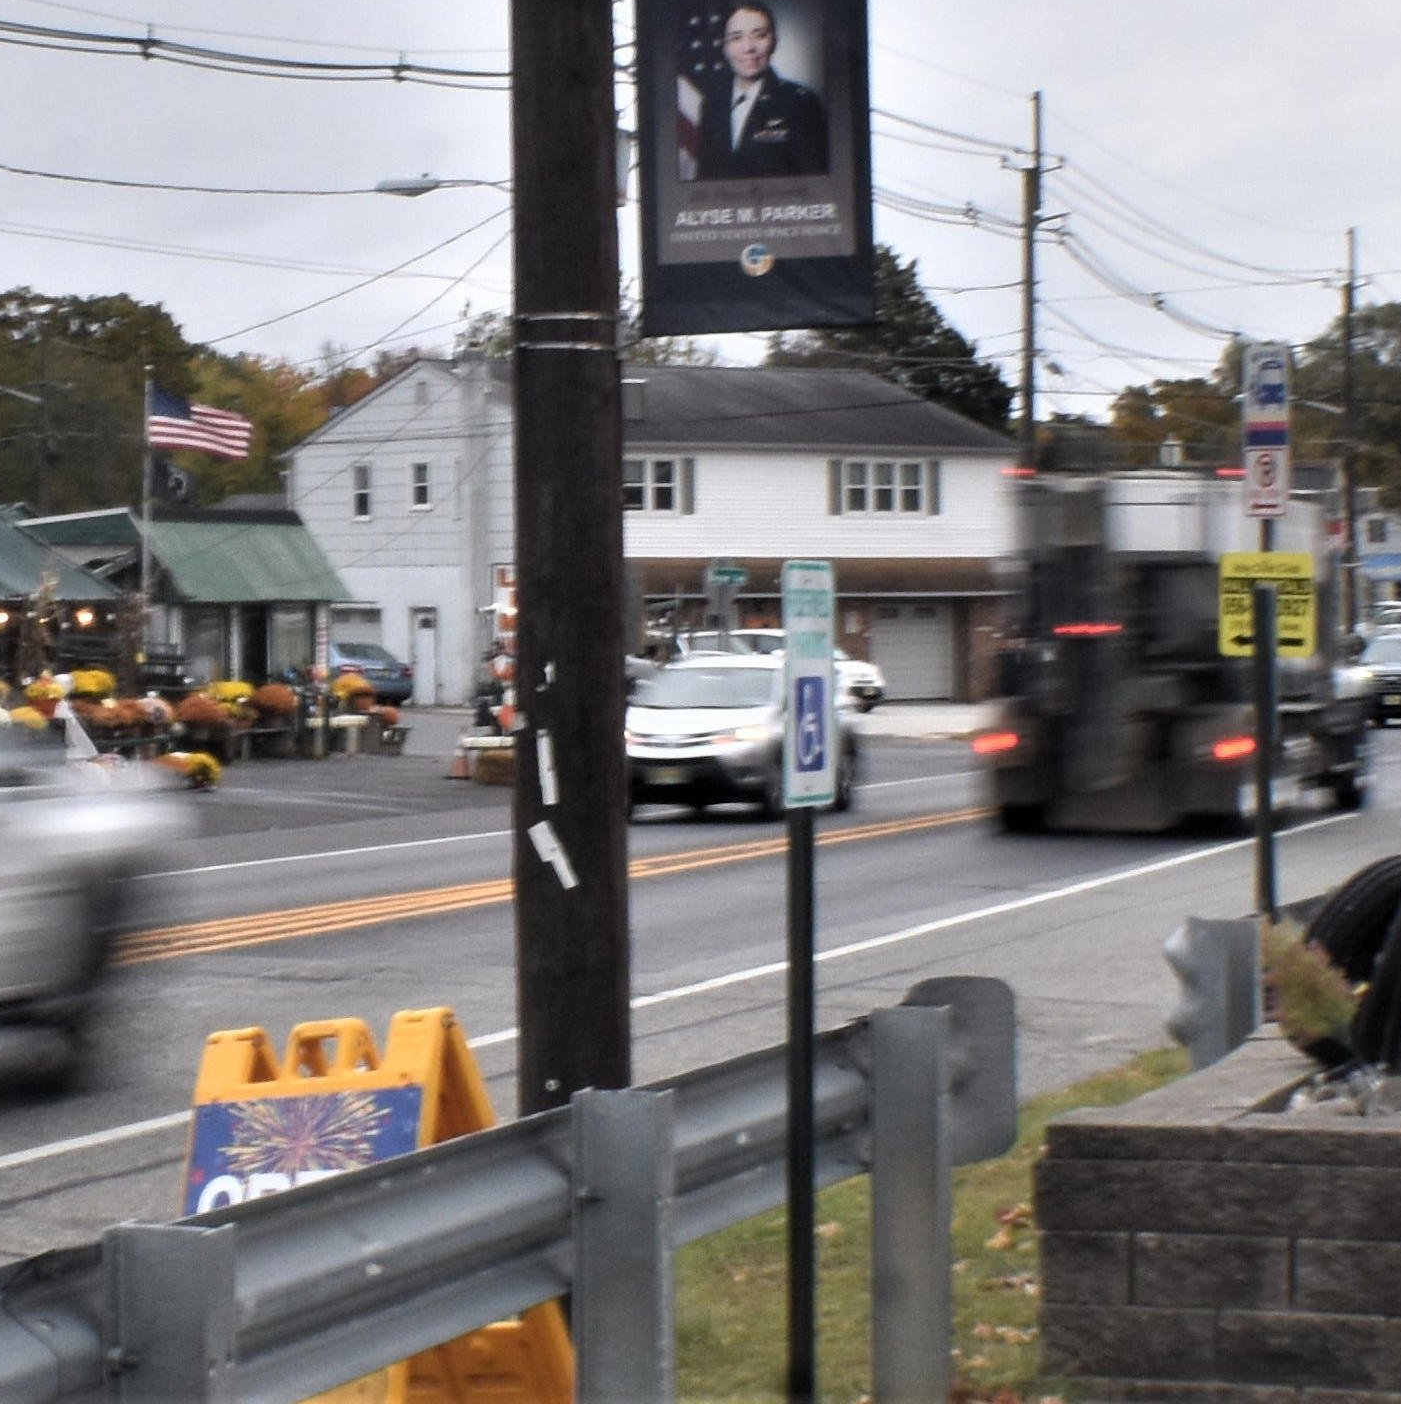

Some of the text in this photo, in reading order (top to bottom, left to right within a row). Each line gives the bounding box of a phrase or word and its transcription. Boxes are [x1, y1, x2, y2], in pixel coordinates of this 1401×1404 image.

[675, 202, 838, 227] ALYSE M. PARKER
